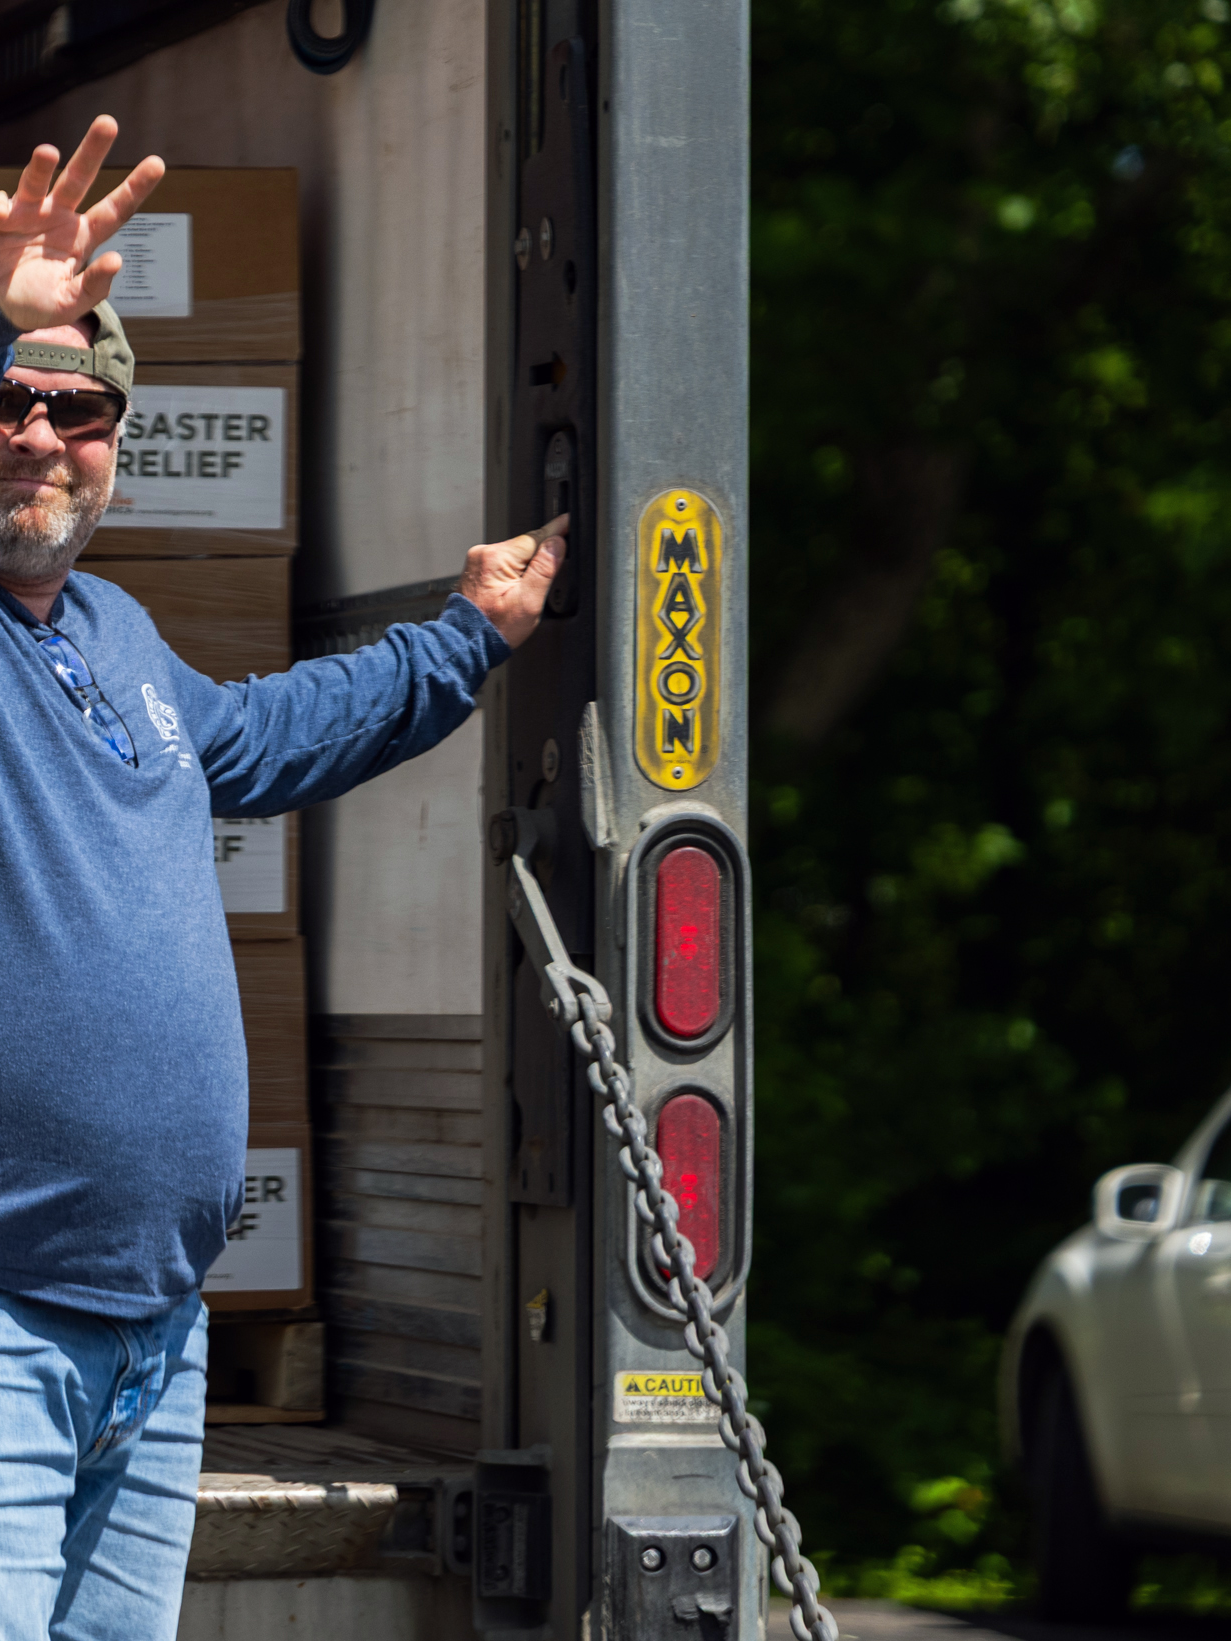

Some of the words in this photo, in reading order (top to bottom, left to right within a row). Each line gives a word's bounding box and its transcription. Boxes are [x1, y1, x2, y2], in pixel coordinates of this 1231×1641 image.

[126, 411, 272, 442] SASTER
[655, 528, 703, 756] MAXON
[644, 1377, 700, 1393] CAUTI
